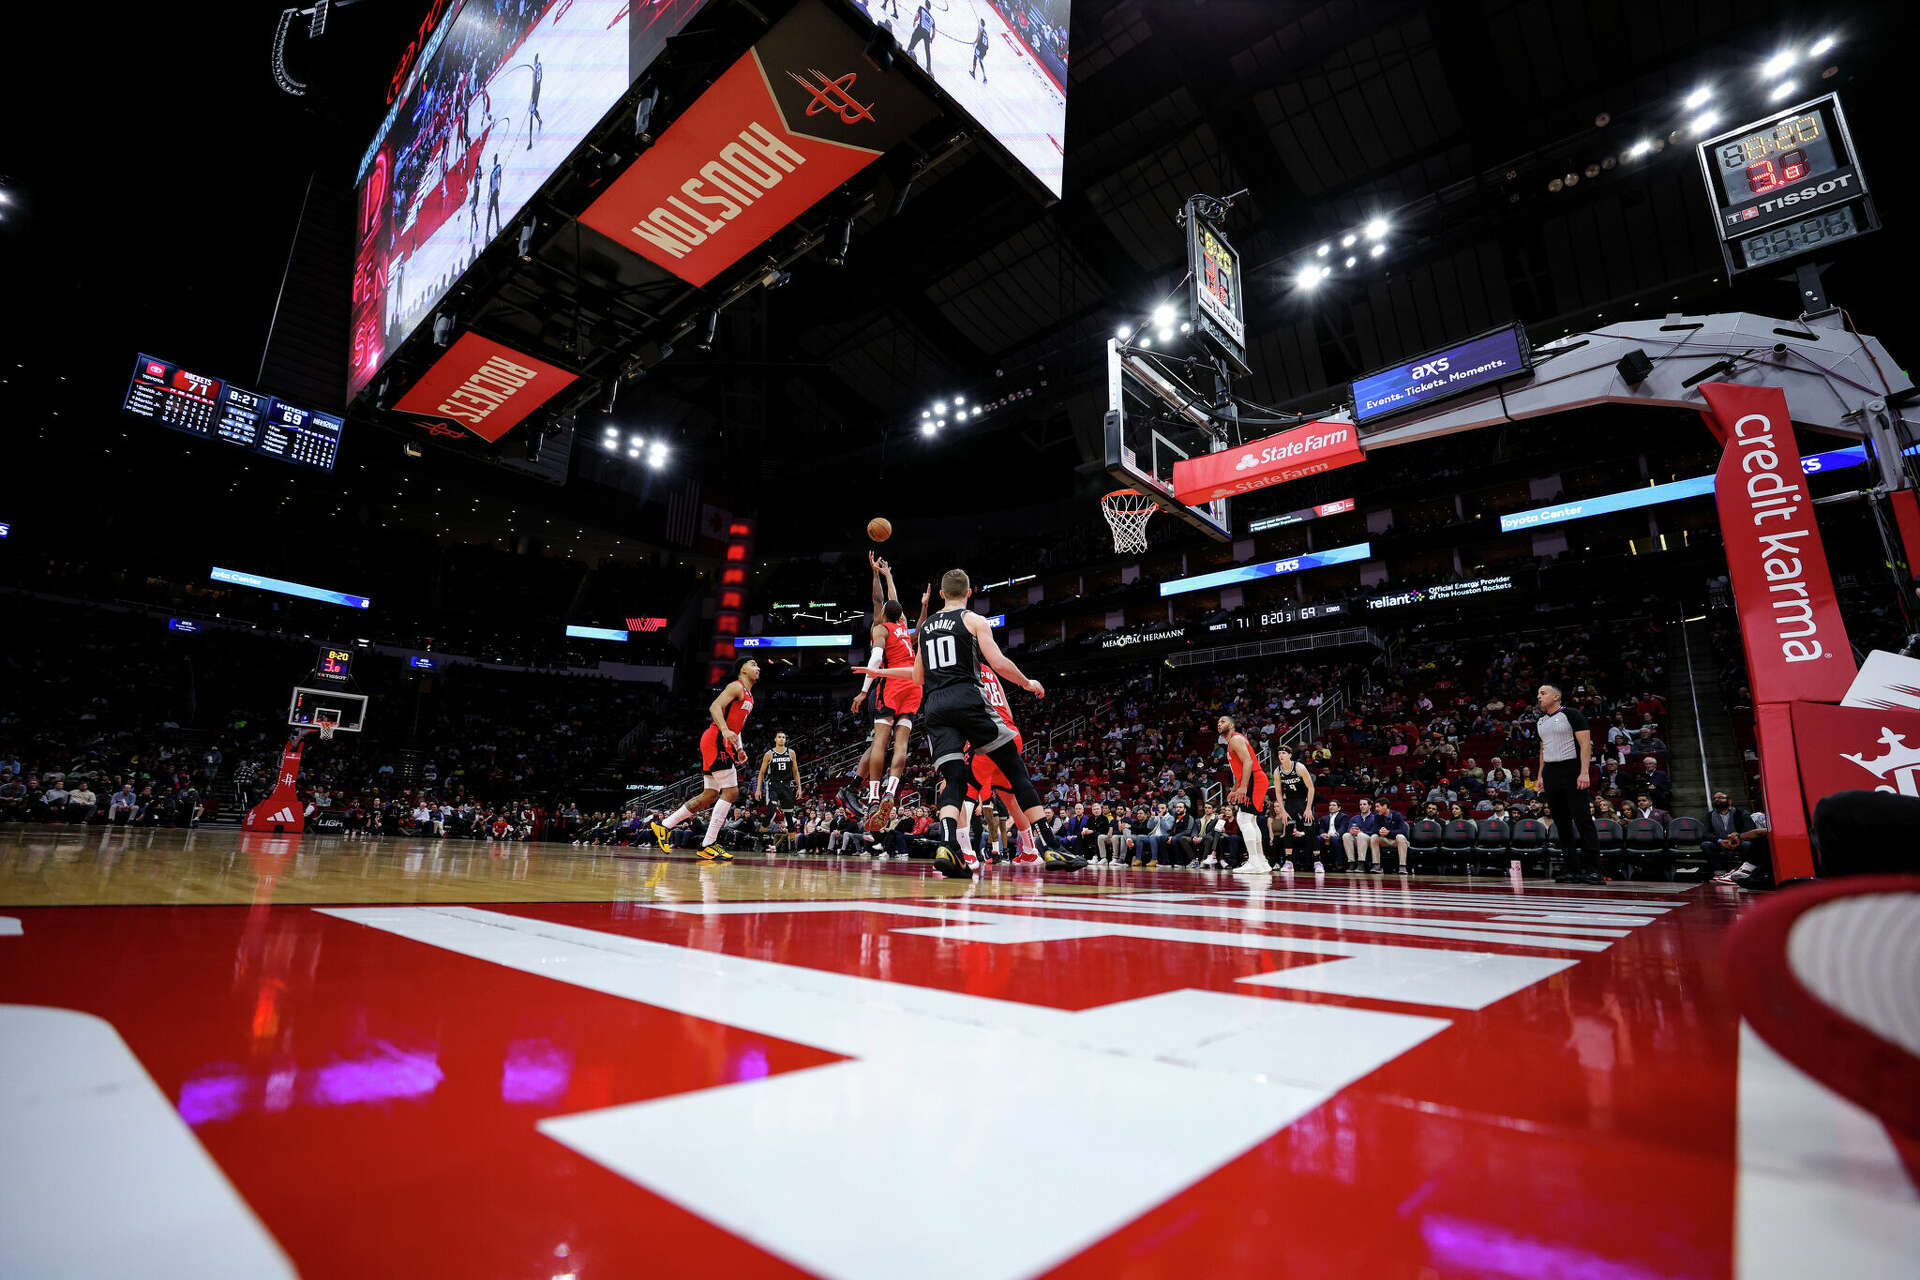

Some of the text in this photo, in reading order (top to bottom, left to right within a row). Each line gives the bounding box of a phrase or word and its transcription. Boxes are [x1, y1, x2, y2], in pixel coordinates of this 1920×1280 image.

[1745, 116, 1819, 160] 8:20
[631, 121, 807, 259] HOUSTON
[1758, 174, 1852, 213] TISSOT
[1411, 357, 1450, 380] axs
[142, 373, 165, 384] TOYOTA
[188, 381, 208, 396] 71
[437, 355, 538, 423] ROCKETS
[1366, 368, 1506, 410] Events. Tickets. Moments.
[230, 390, 259, 407] 8:21
[283, 411, 303, 426] 69
[1735, 413, 1802, 526] credit
[1540, 506, 1582, 520] Center
[1428, 576, 1511, 594] Official Energy Provider
[1437, 590, 1450, 599] the
[1450, 587, 1482, 597] Houston
[1482, 582, 1512, 593] Rockets
[1370, 593, 1412, 610] reliant
[1758, 529, 1823, 663] karma
[924, 619, 956, 635] SABONIS
[1236, 618, 1249, 629] 71
[1261, 612, 1284, 626] 8:20
[1301, 607, 1316, 620] 69
[1102, 628, 1185, 648] MEMORIAL HERMANN
[329, 651, 349, 661] 8:20
[925, 635, 957, 670] 10
[778, 762, 787, 771] 13
[318, 818, 345, 827] LIGH
